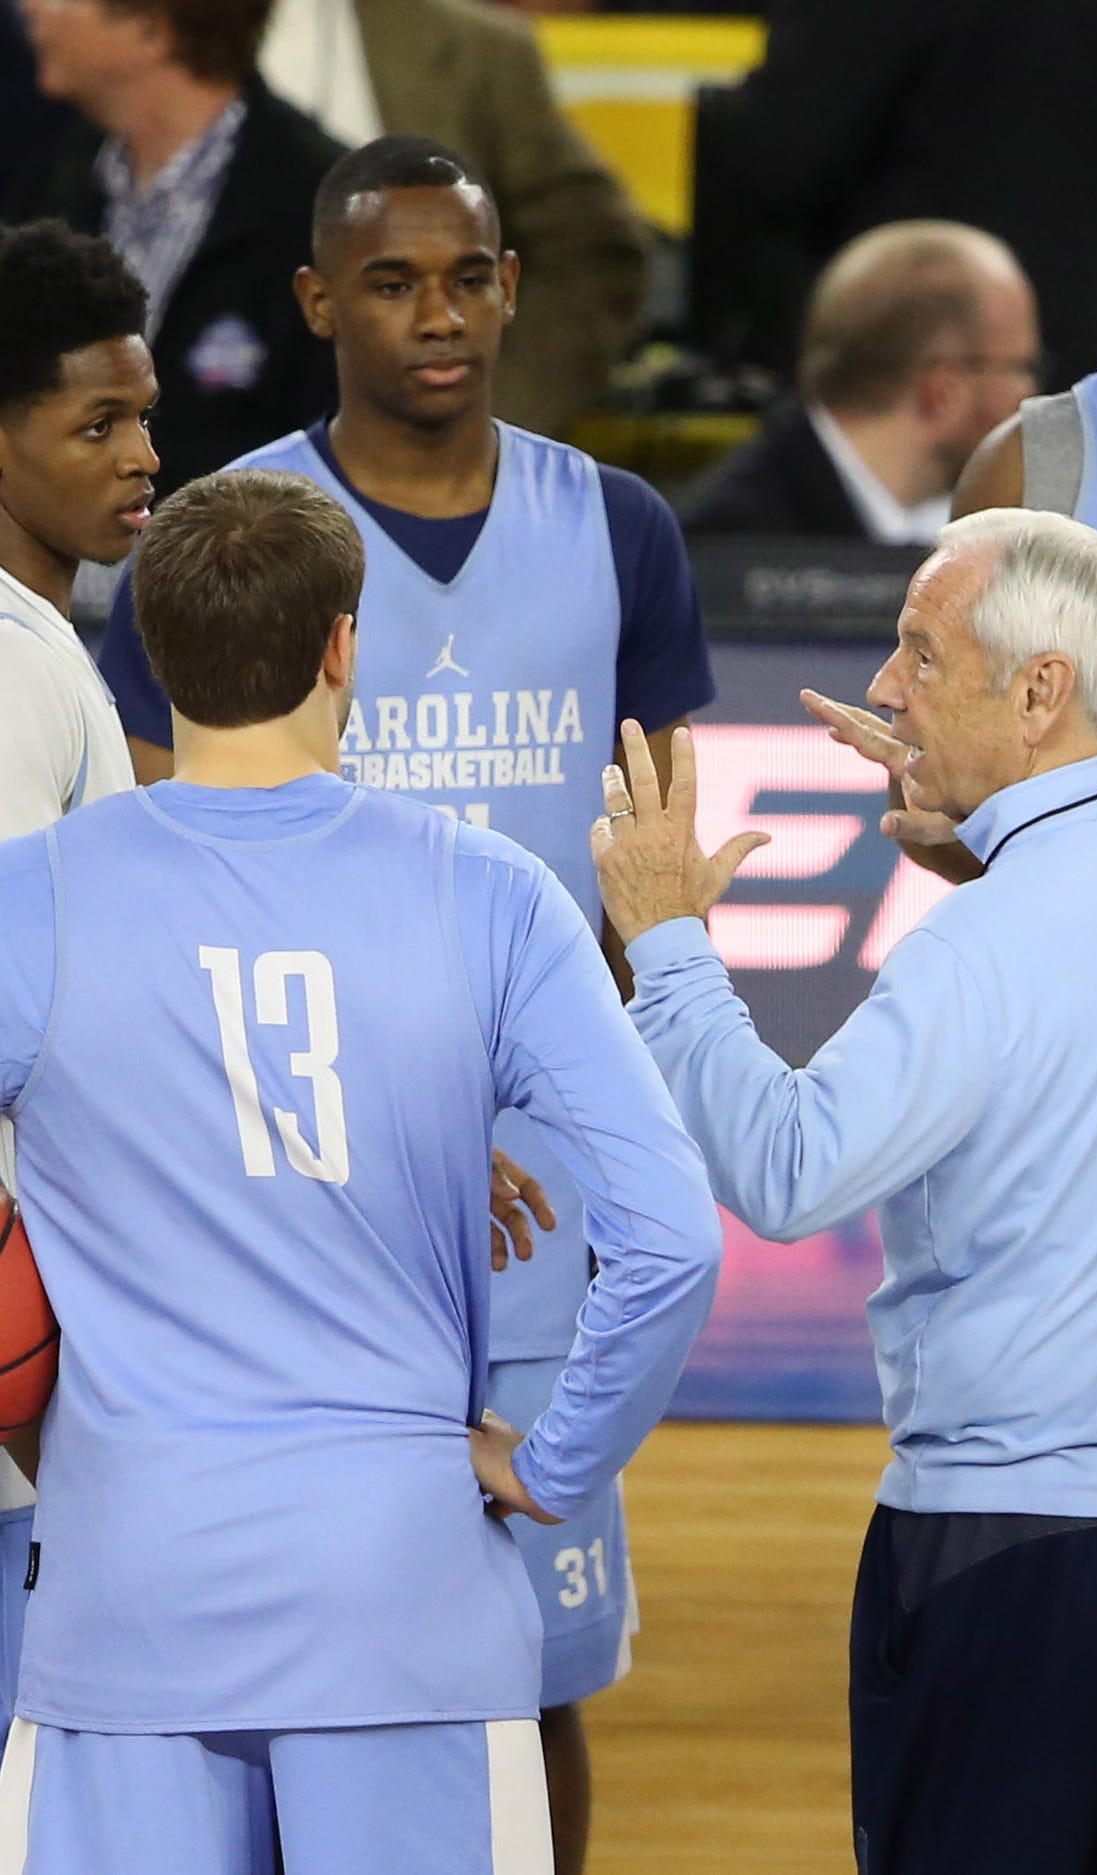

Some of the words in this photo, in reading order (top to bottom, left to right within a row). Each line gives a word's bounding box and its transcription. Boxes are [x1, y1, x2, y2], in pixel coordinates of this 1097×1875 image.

[339, 687, 585, 752] AROLINA
[362, 746, 566, 791] BASKETBALL
[198, 944, 351, 1188] 13
[554, 1536, 608, 1610] 31
